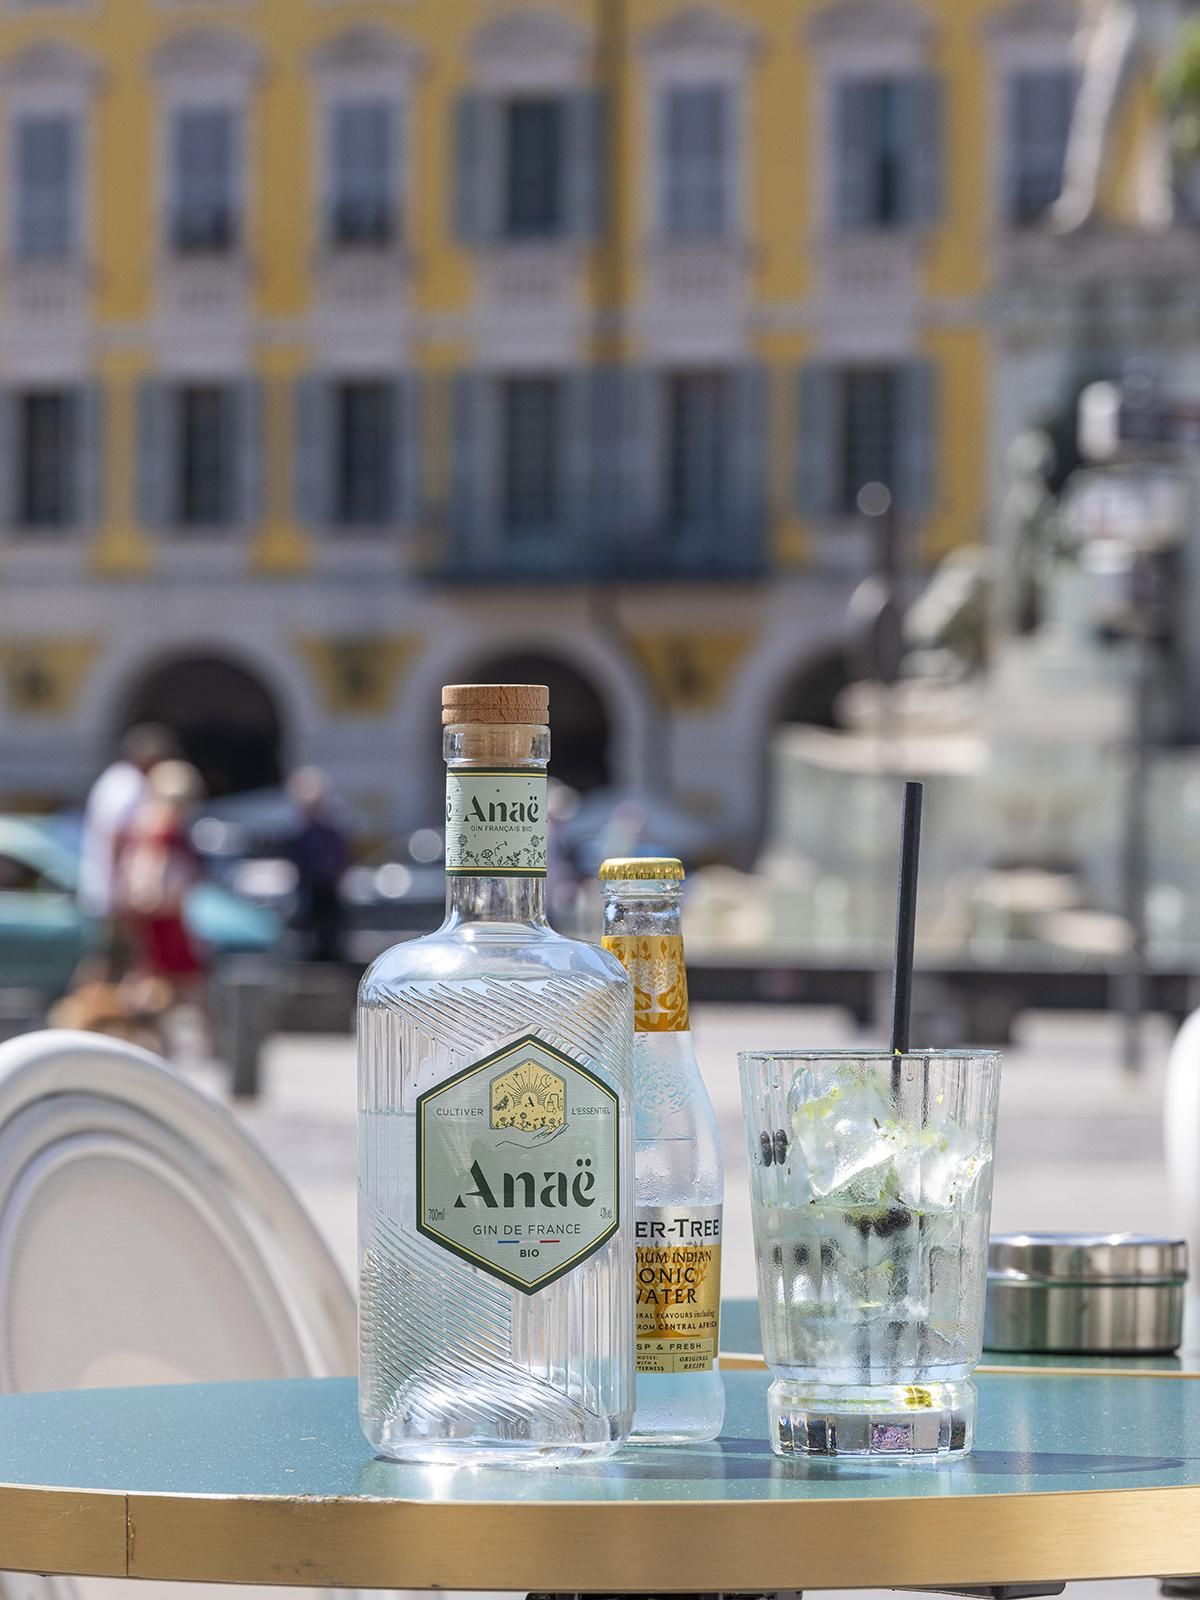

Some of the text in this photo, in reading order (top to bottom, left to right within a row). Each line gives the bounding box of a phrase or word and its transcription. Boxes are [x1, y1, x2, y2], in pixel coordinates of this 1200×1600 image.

[464, 795, 539, 823] Anaë
[485, 825, 520, 833] FRANÇAIS
[436, 1107, 484, 1116] CULTIVER
[571, 1106, 611, 1116] L'ESSENTIEL
[453, 1158, 596, 1208] Anaë
[472, 1223, 581, 1235] GIN DE FRANCE
[635, 1218, 719, 1238] ER-TREE
[519, 1249, 540, 1258] BIO
[635, 1250, 712, 1264] IUM INDIAN
[639, 1267, 696, 1284] ONIC
[694, 1309, 716, 1318] including
[656, 1343, 664, 1351] &
[669, 1342, 702, 1350] FRESH
